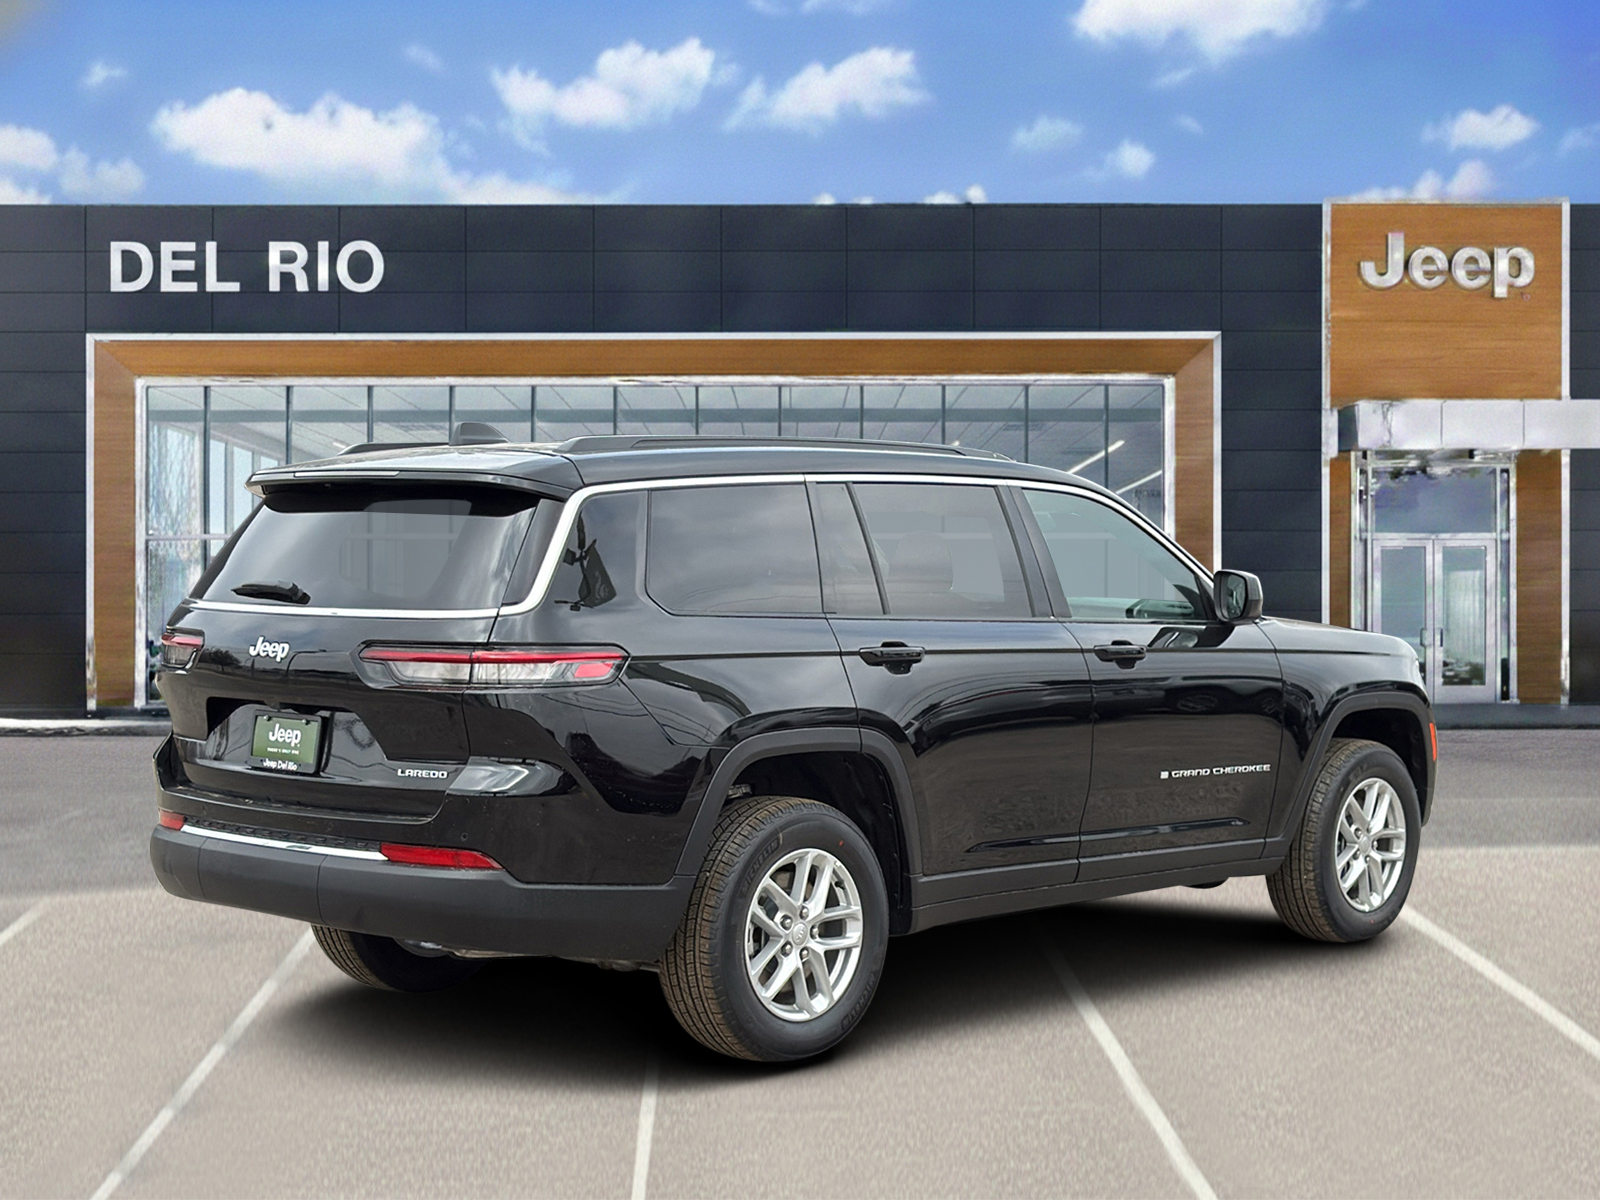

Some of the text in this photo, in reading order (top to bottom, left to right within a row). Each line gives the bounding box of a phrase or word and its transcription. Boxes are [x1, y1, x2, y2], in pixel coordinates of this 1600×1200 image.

[110, 240, 385, 293] DEL RIO
[1359, 231, 1535, 298] Jeep
[249, 636, 290, 663] Jeep
[268, 723, 301, 747] Jeep
[397, 768, 448, 779] LAREDO
[1171, 764, 1271, 778] GRAND CHEROKEE
